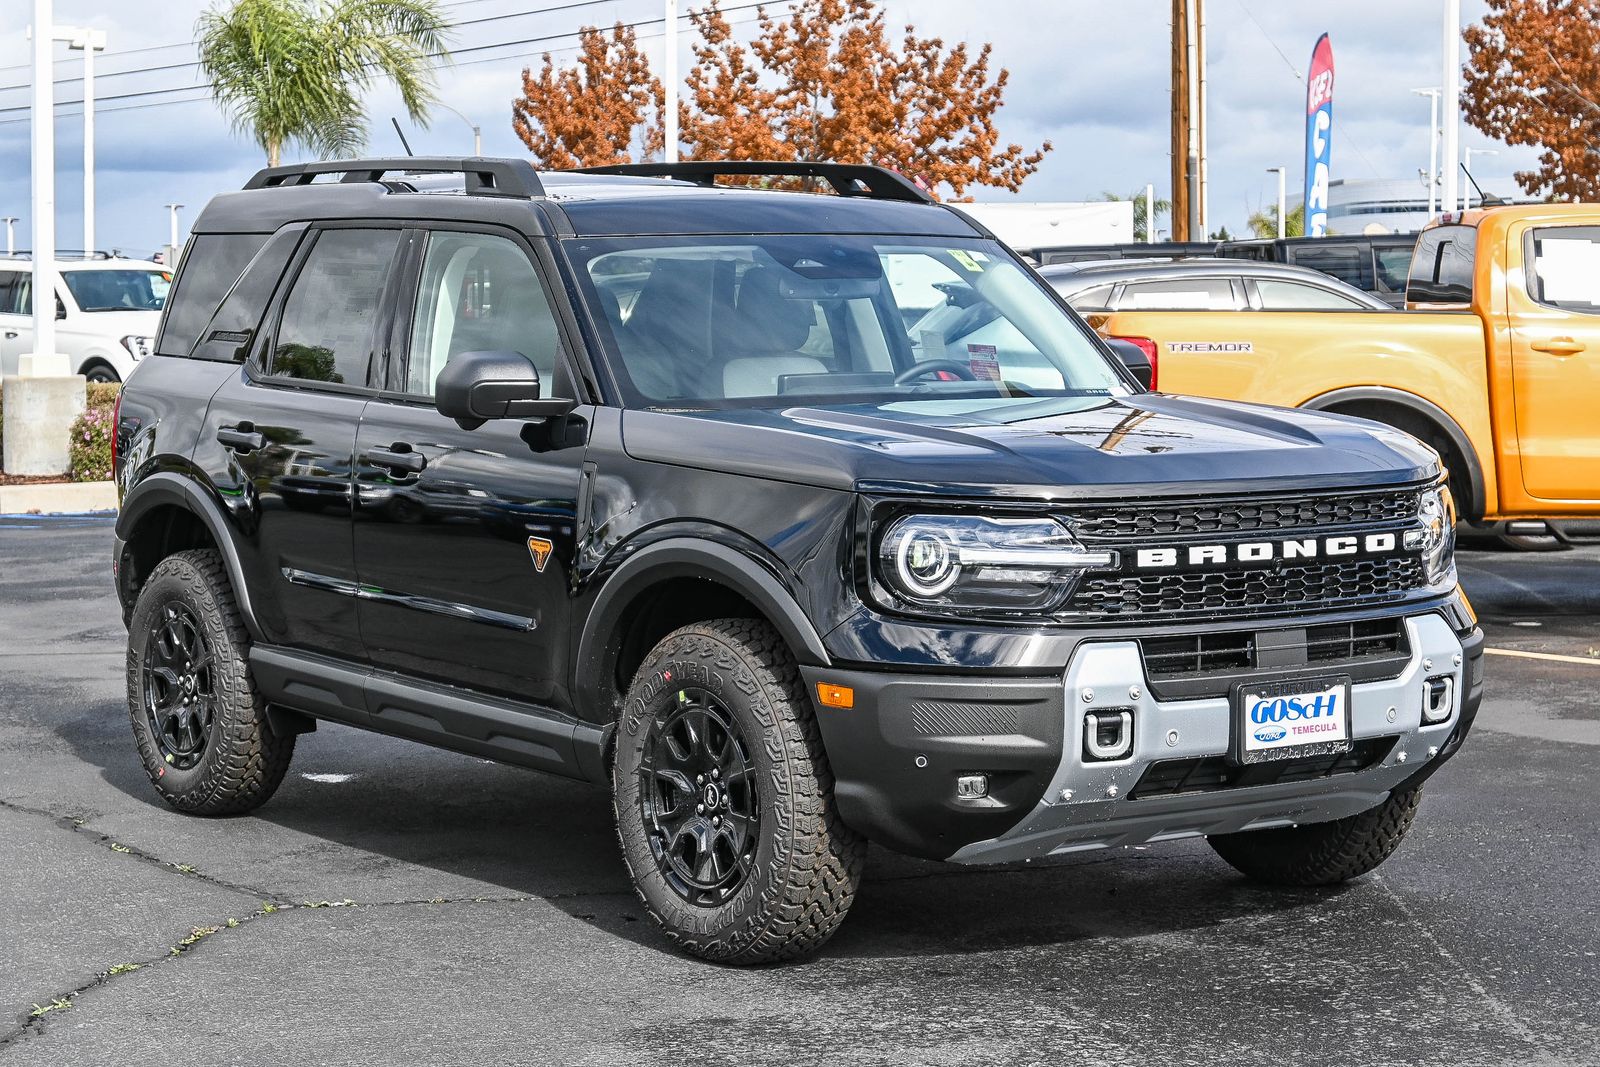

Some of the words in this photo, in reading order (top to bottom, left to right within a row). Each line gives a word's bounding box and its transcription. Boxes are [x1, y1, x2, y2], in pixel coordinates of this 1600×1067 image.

[1165, 341, 1253, 353] TREMOR
[1137, 533, 1396, 567] BRONCO
[626, 659, 724, 737] GOODYEAR
[1292, 723, 1337, 735] TEMECULA
